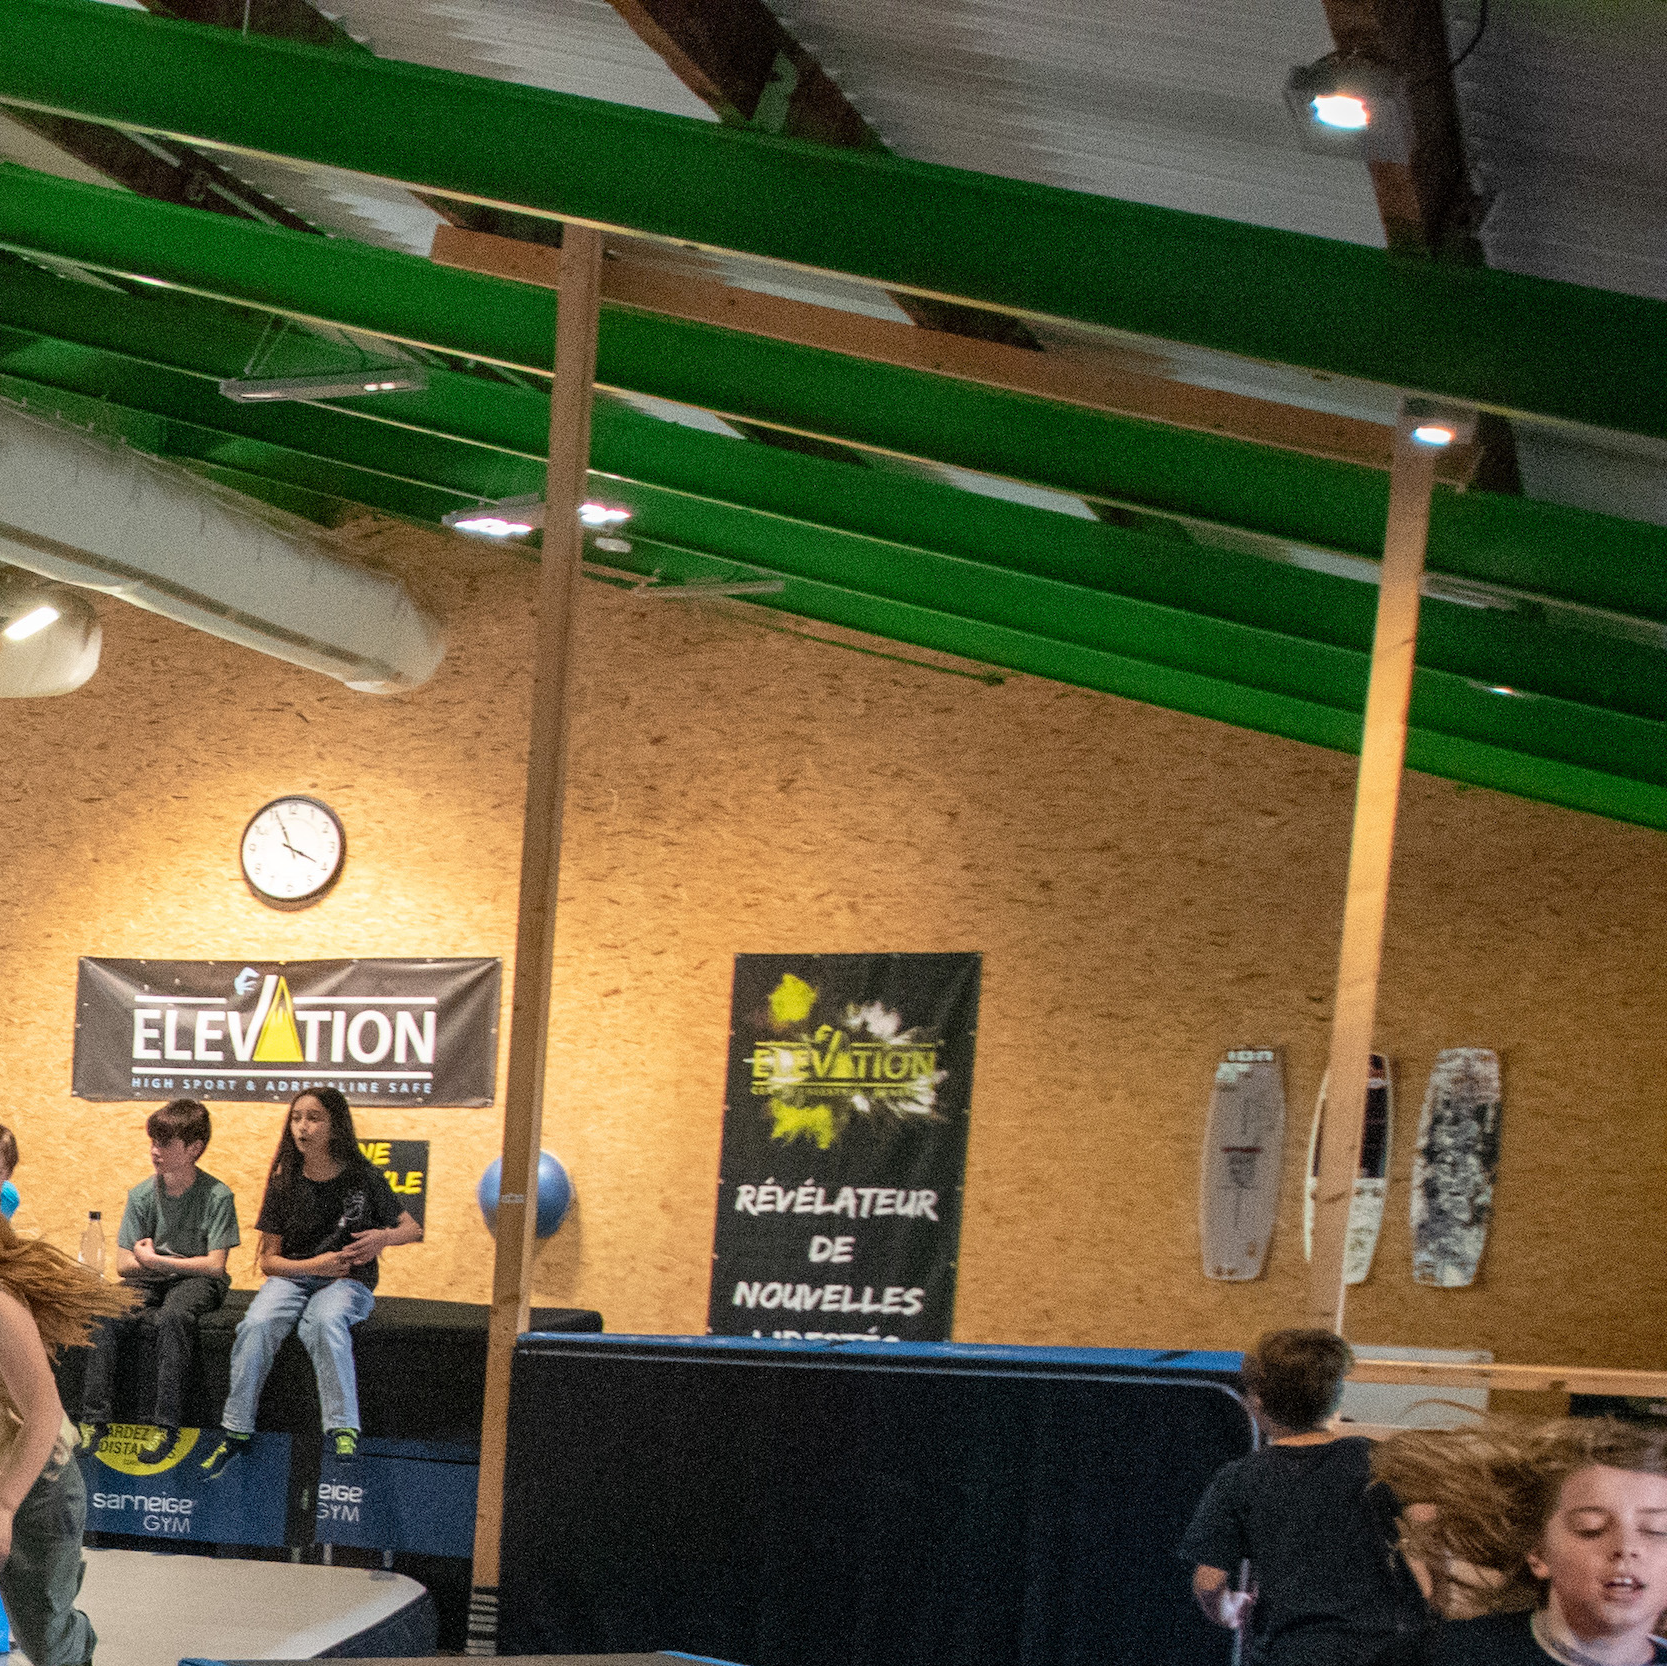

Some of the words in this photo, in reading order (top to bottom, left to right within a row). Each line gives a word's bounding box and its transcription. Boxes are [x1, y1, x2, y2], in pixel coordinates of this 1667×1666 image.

[132, 974, 437, 1064] ELEVATION
[131, 1077, 175, 1089] HIGH
[183, 1078, 236, 1091] SPORT
[246, 1080, 256, 1092] &
[388, 1082, 433, 1095] SAFE
[735, 1177, 939, 1222] RÉVÉLATEUR
[808, 1235, 856, 1263] DE
[733, 1281, 925, 1316] NOUVELLES
[318, 1479, 364, 1503] eige
[143, 1514, 191, 1534] GYM
[316, 1502, 360, 1523] GYM
